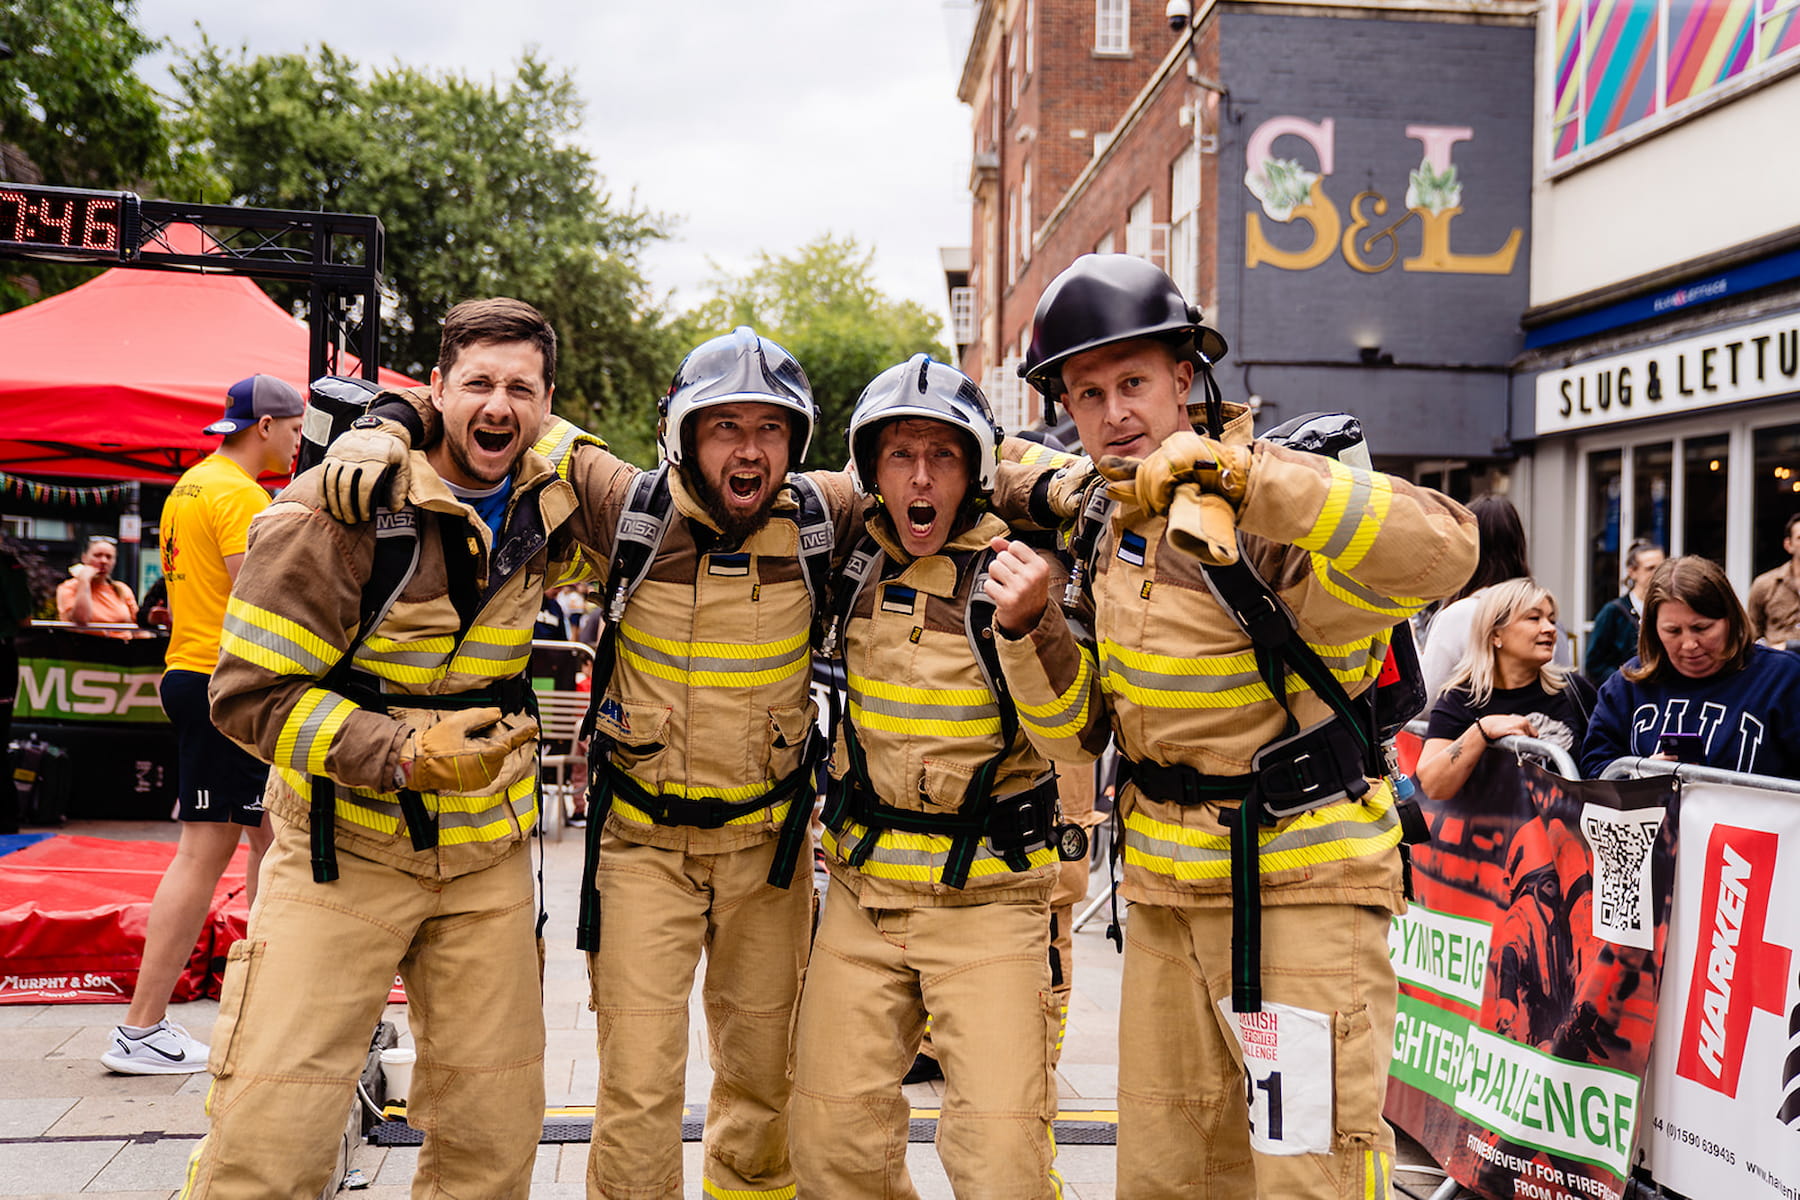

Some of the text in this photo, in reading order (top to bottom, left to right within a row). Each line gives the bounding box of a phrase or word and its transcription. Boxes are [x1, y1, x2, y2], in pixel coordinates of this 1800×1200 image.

[1559, 329, 1799, 418] SLUG & LETTU
[14, 665, 169, 715] MSA
[195, 789, 210, 809] JJ
[1698, 843, 1753, 1079] HARKEN
[1, 975, 68, 990] MURPHY
[69, 977, 81, 988] &
[1392, 1012, 1464, 1088] GHTER
[1494, 1151, 1534, 1177] EVENT
[1535, 1164, 1565, 1186] FOR
[1701, 1139, 1736, 1166] 639435
[1513, 1178, 1550, 1200] FROM
